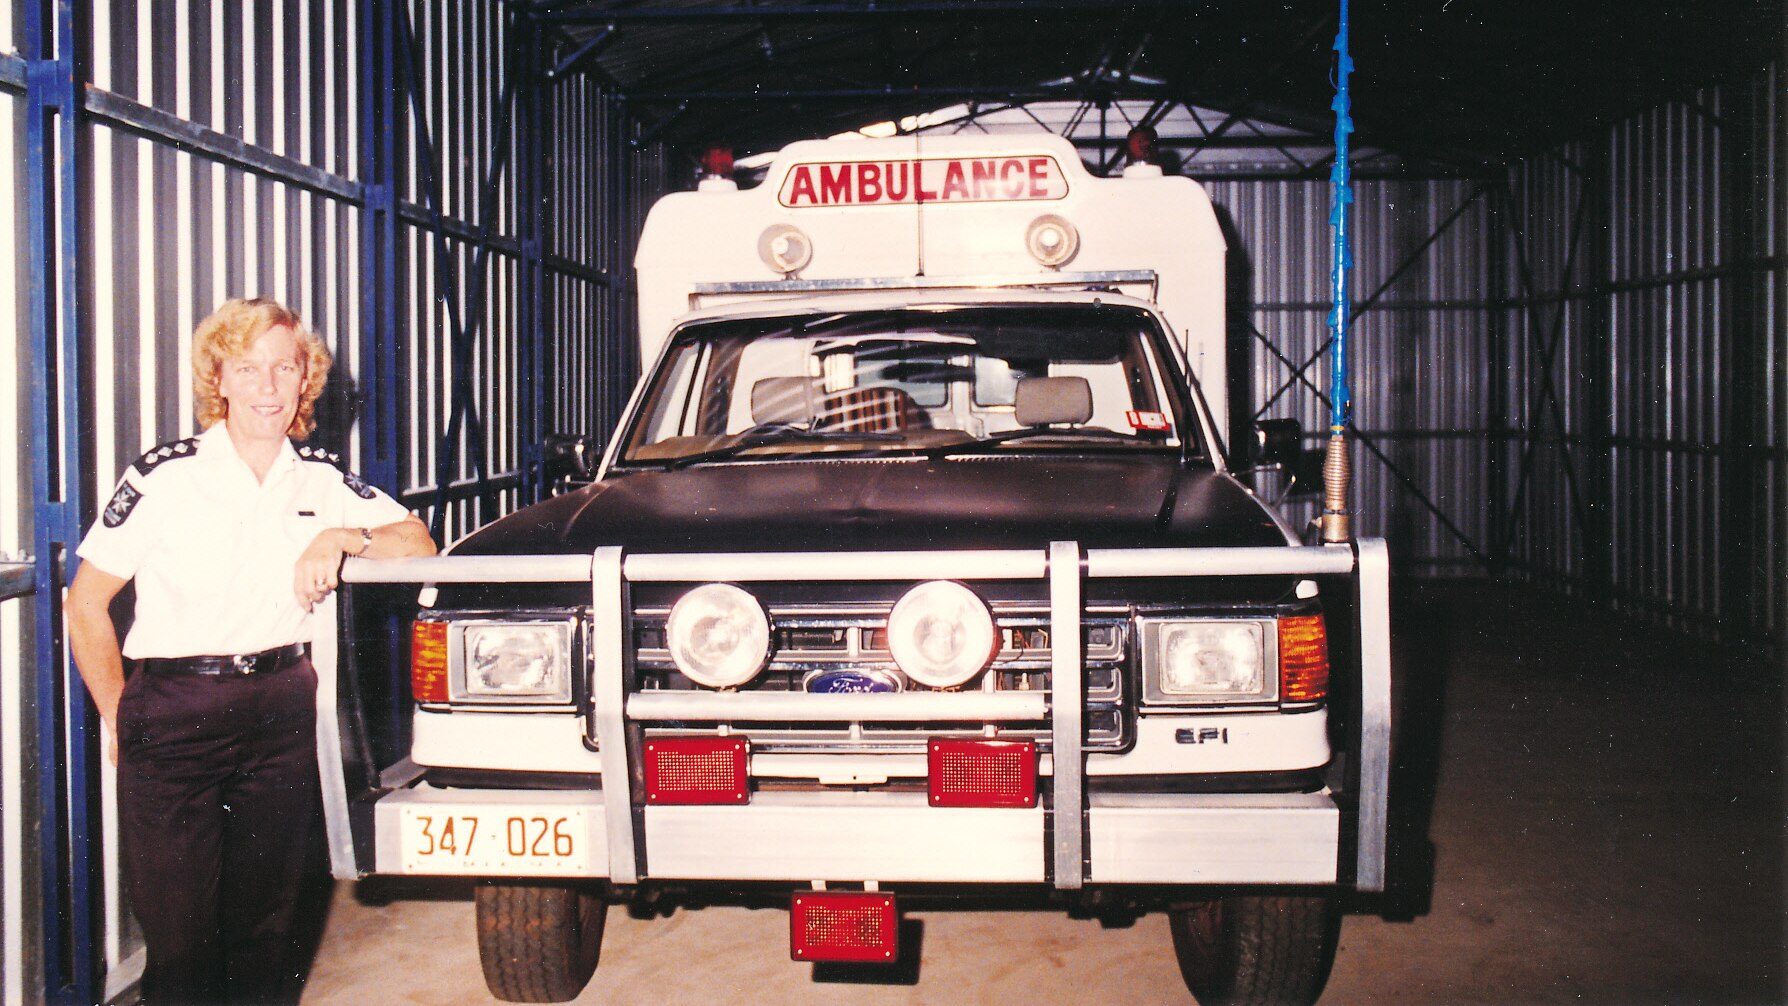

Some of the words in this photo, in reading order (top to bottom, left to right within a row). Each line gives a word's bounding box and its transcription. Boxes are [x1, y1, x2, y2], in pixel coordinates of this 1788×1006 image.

[789, 158, 1049, 206] AMBULANCE
[828, 678, 875, 694] Ford
[1175, 728, 1228, 744] EFI
[416, 816, 478, 857] 347
[507, 816, 573, 857] 026
